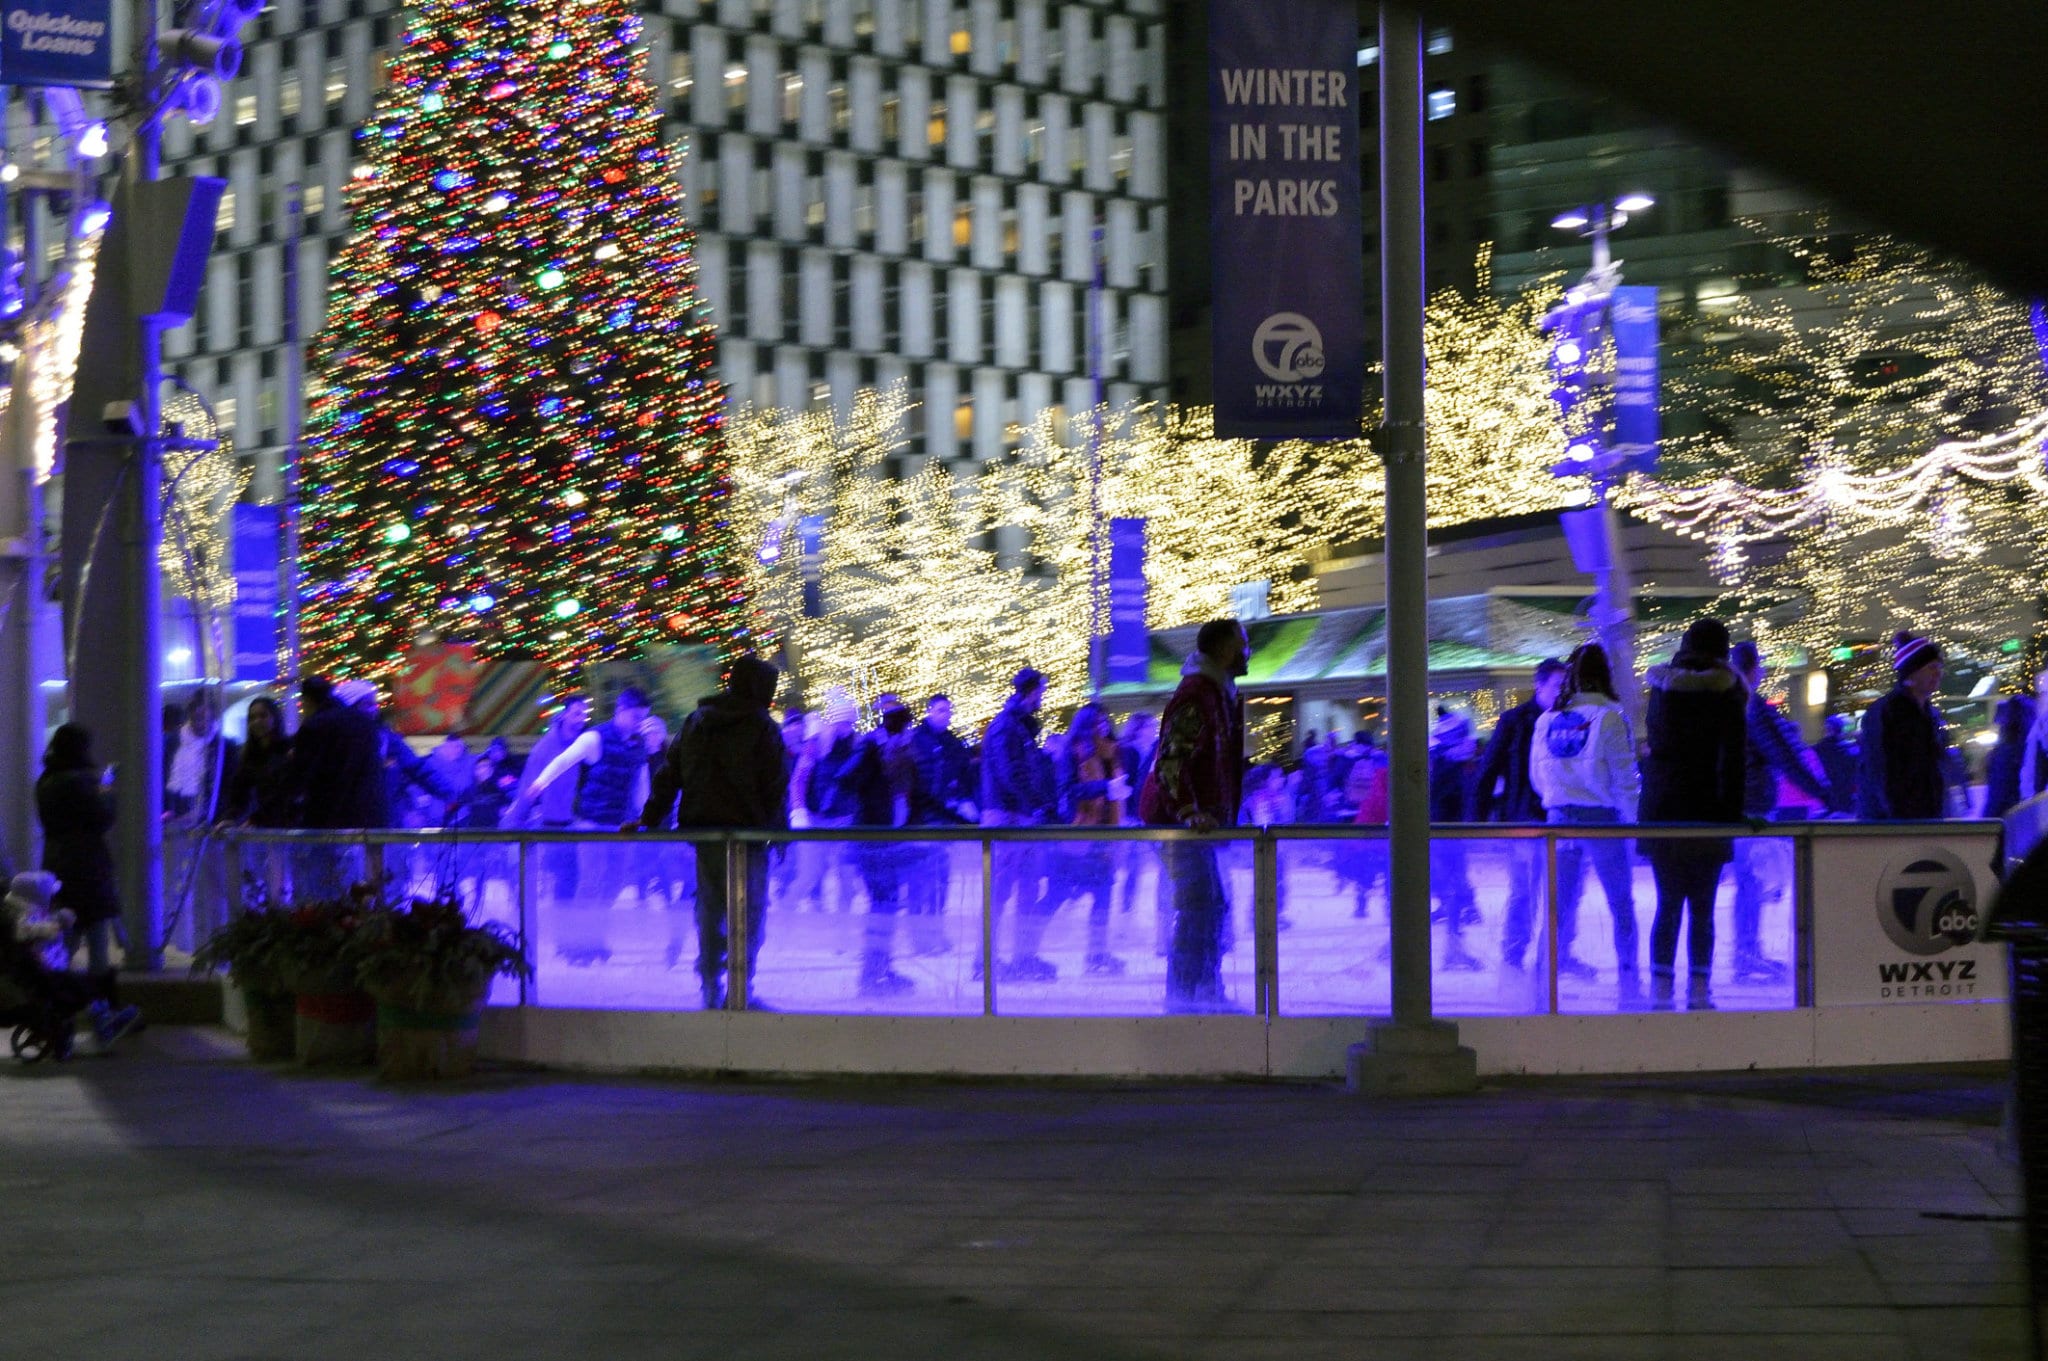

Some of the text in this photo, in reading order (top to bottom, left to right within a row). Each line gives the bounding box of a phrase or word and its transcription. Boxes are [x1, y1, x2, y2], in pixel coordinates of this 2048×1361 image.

[8, 9, 105, 37] Quicken
[21, 31, 96, 56] Loans
[1221, 68, 1347, 107] WINTER
[1230, 124, 1341, 162] IN THE
[1235, 179, 1339, 218] PARKS
[1296, 353, 1324, 368] abc
[1255, 384, 1322, 398] WXYZ
[1257, 399, 1321, 408] DETROIT
[1939, 909, 1978, 931] abc
[1879, 960, 1977, 983] WXYZ
[1881, 983, 1975, 998] DETROIT
